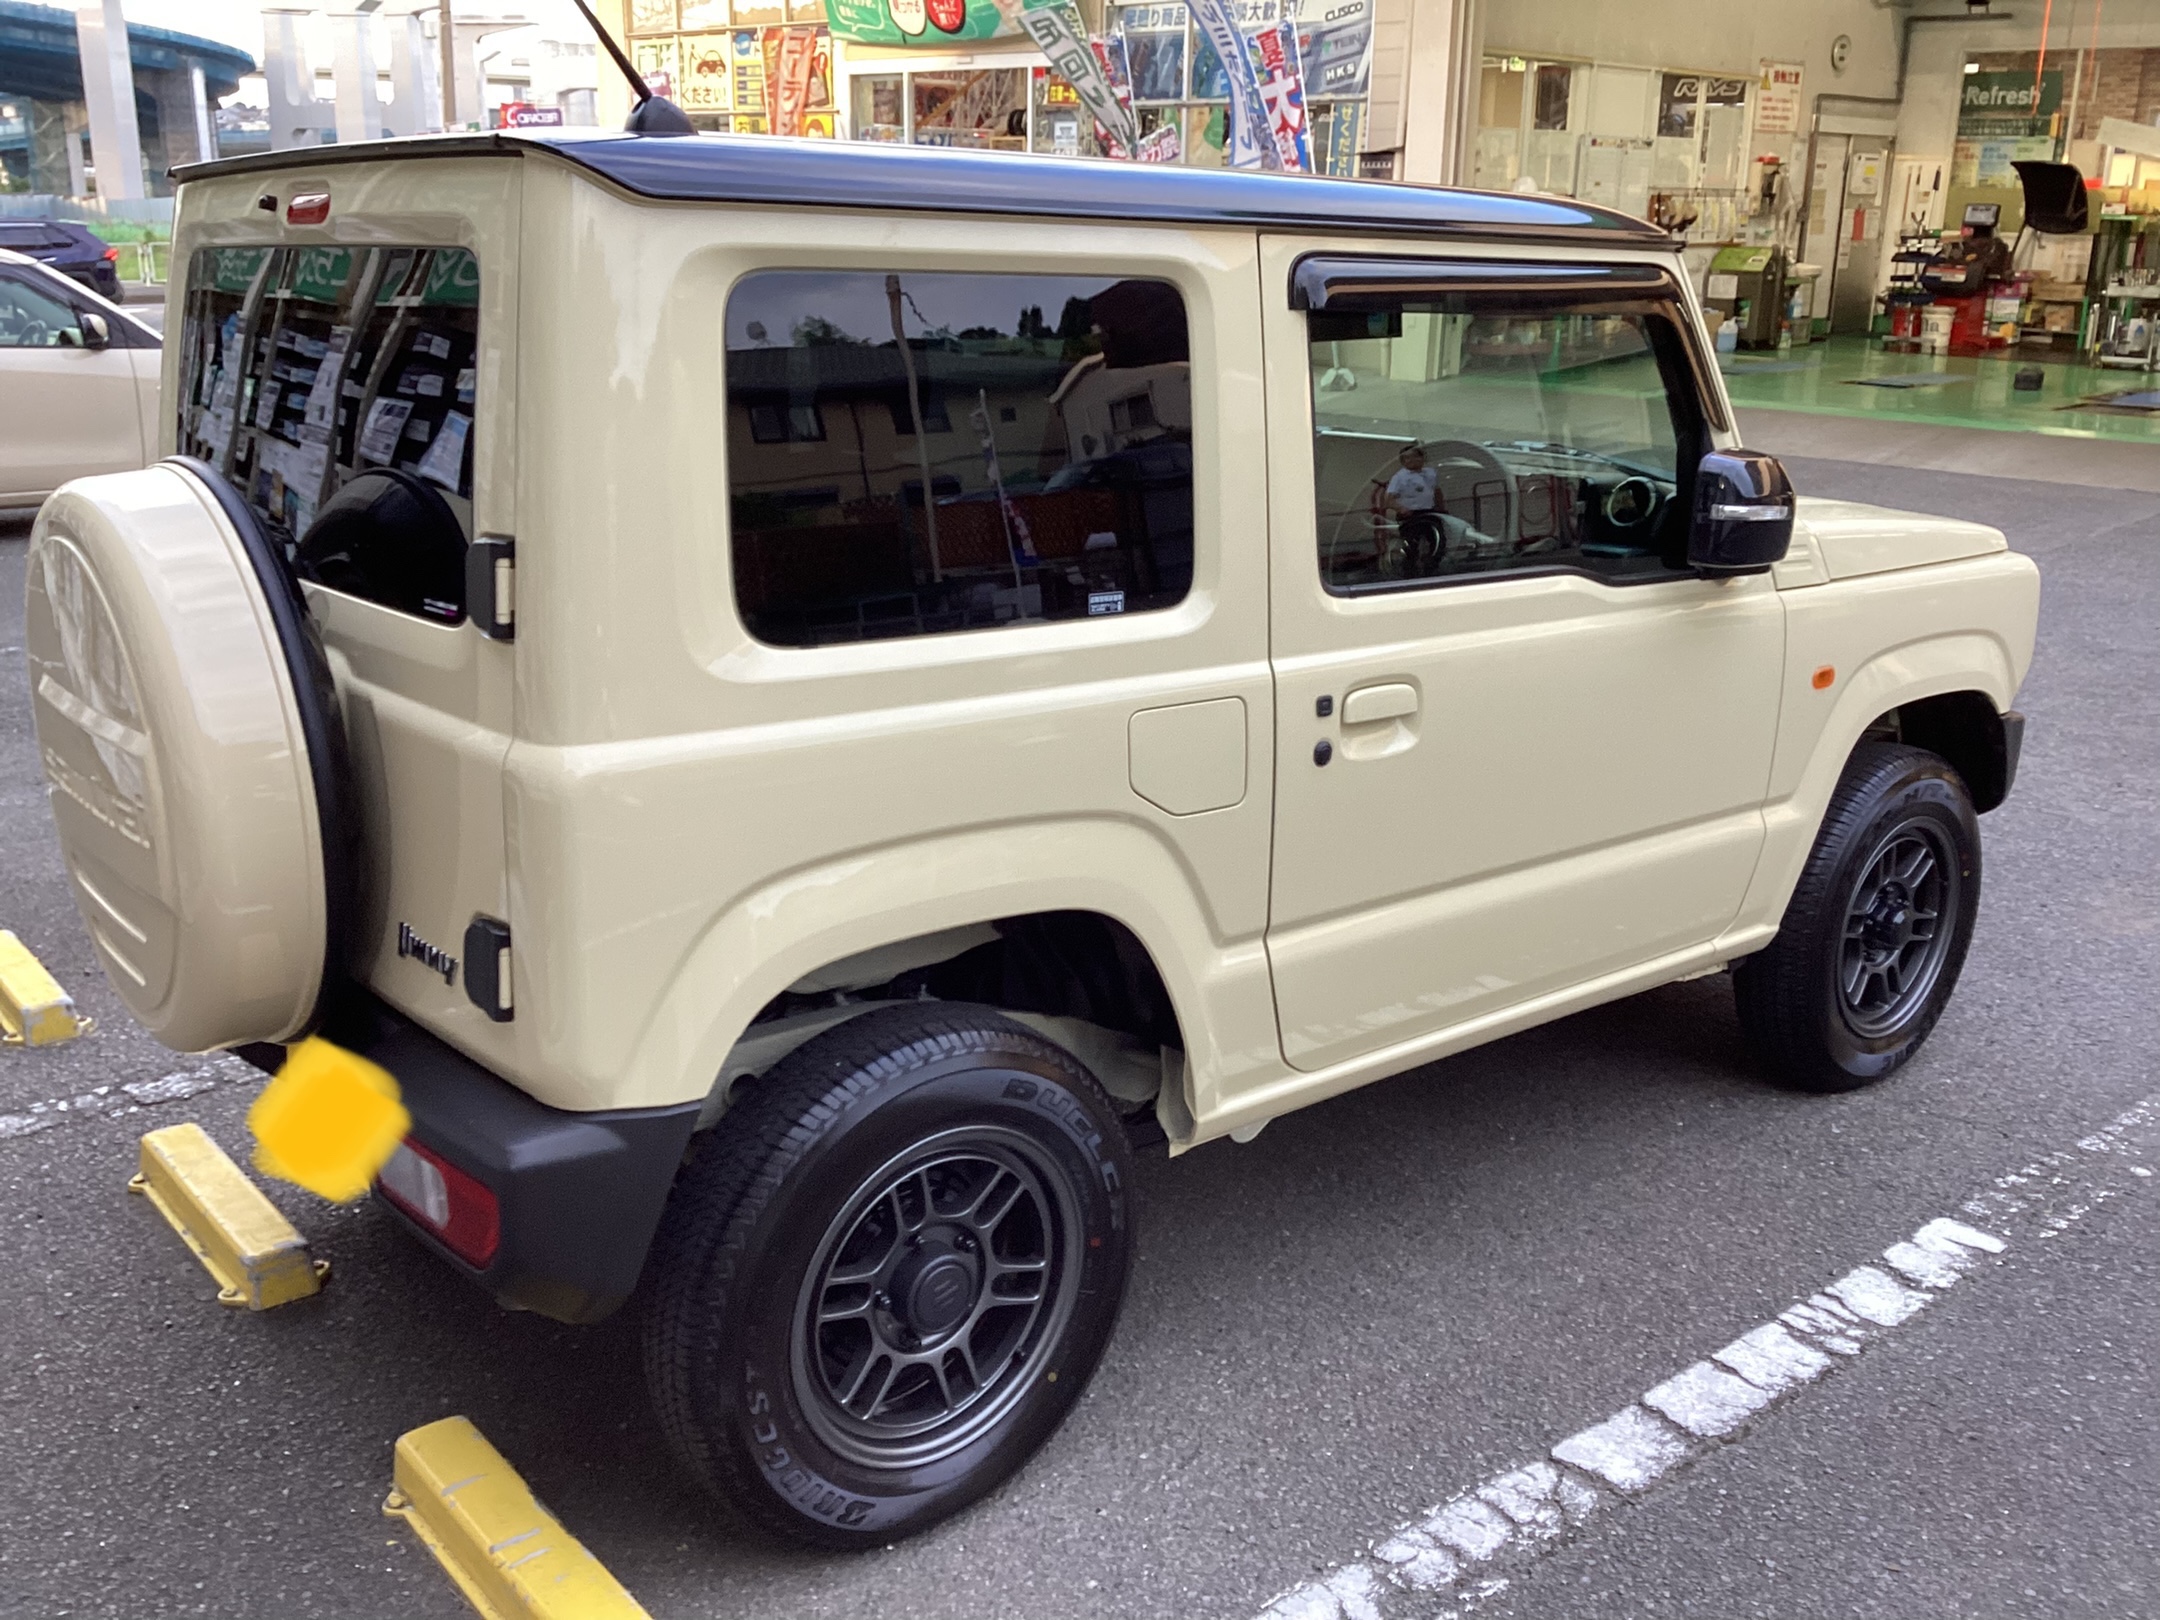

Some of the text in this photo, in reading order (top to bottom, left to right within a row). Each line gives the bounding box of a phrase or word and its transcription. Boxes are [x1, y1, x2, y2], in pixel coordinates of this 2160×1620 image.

[1325, 2, 1363, 22] CUSCO
[1326, 63, 1356, 81] HKS
[398, 922, 460, 987] Jimny
